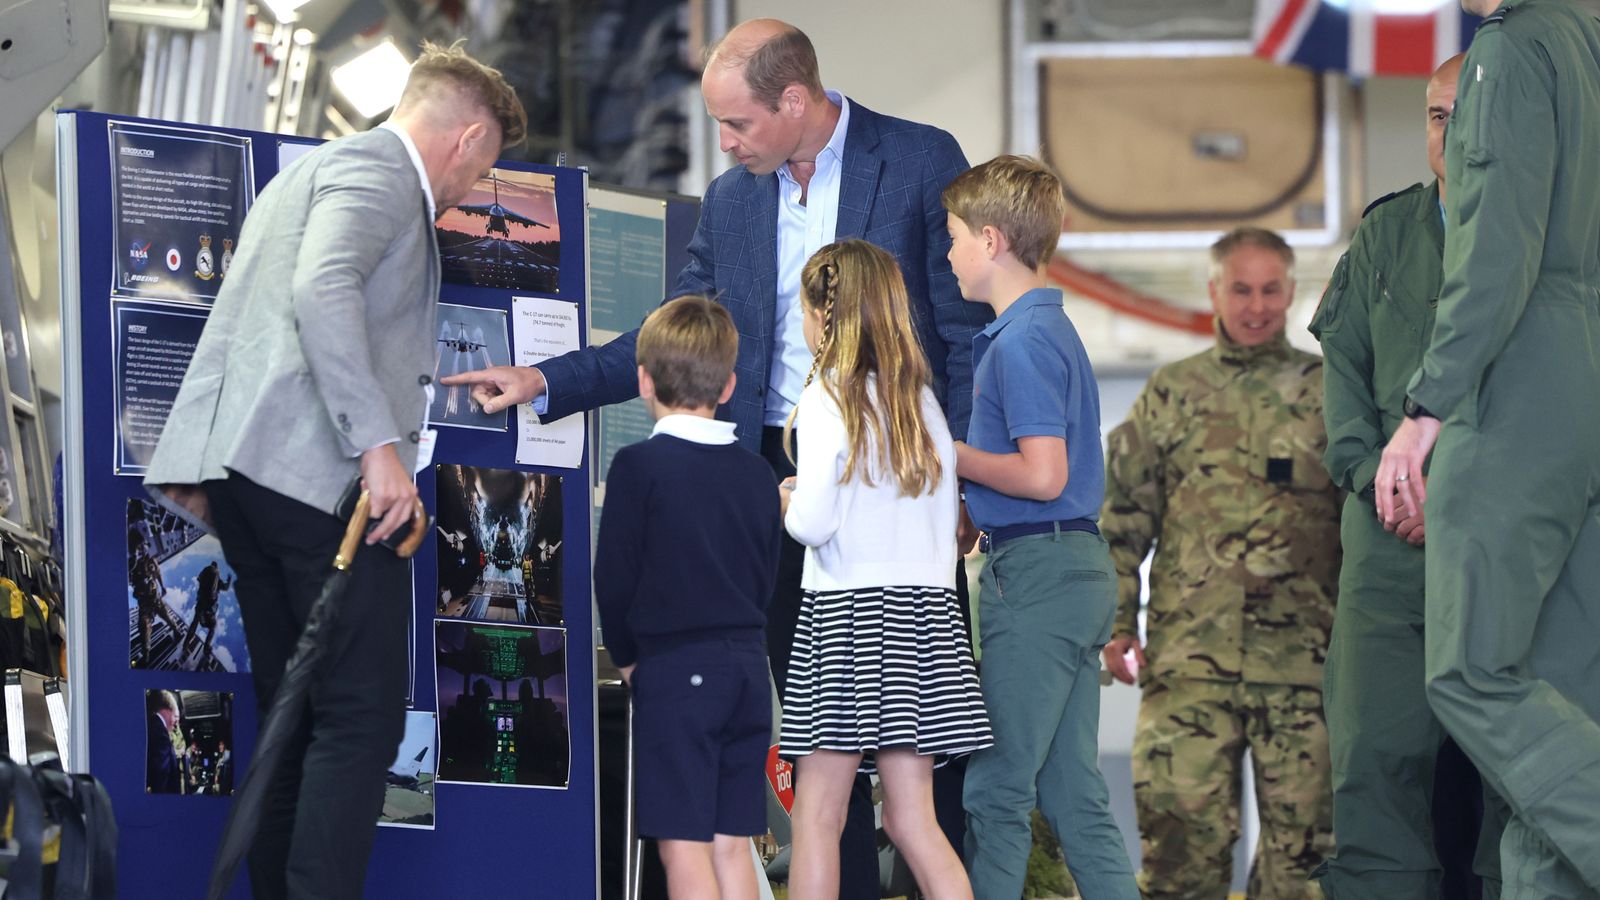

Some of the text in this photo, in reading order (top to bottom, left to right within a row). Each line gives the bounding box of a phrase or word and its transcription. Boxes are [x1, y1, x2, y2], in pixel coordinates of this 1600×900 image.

[120, 147, 154, 157] INTRODUCTION
[130, 250, 148, 258] NASA
[131, 274, 160, 283] BOEING
[128, 324, 148, 334] HISTORY
[776, 761, 786, 772] RAF
[776, 770, 792, 792] 100
